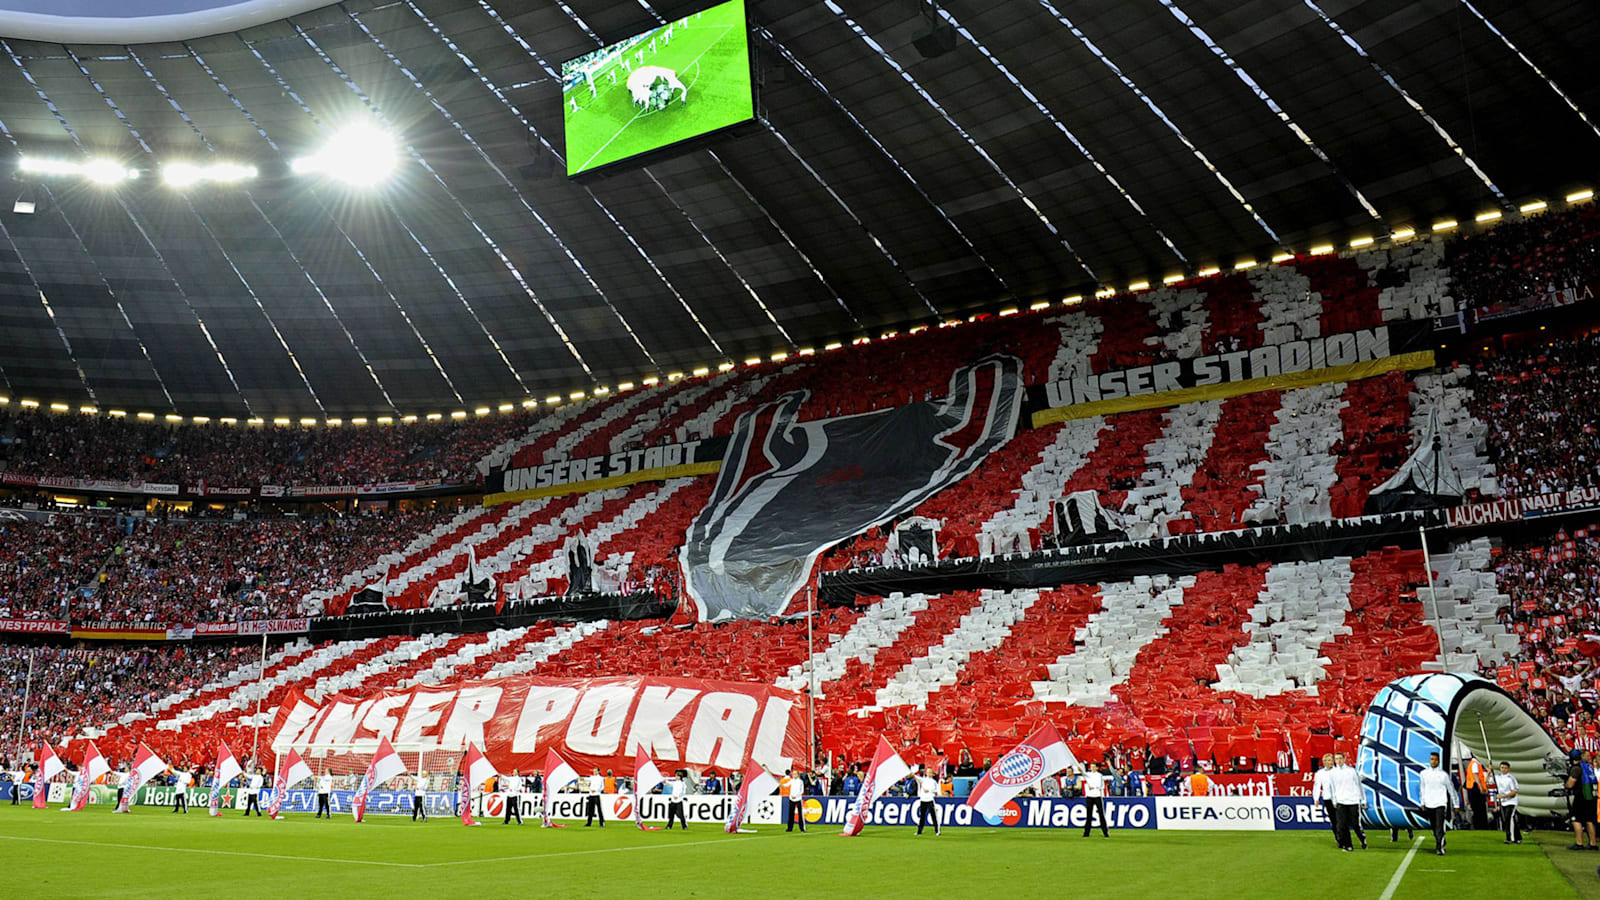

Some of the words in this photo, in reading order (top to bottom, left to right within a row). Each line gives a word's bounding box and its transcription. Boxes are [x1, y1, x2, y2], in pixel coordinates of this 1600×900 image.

[1045, 361, 1181, 409] UNSER
[1193, 325, 1390, 387] STADION
[503, 456, 603, 493] UNSERE
[608, 440, 701, 477] STADT
[1447, 499, 1522, 527] LAUCHA/U.
[0, 620, 67, 633] WESTPFALZ
[271, 686, 503, 758] UNSER
[511, 685, 794, 776] POKAL
[144, 788, 212, 807] Heinke
[283, 791, 341, 811] SVIA
[346, 795, 373, 804] SY
[378, 793, 452, 813] PSVTA
[514, 795, 596, 818] niredi
[640, 797, 732, 820] Uniredi
